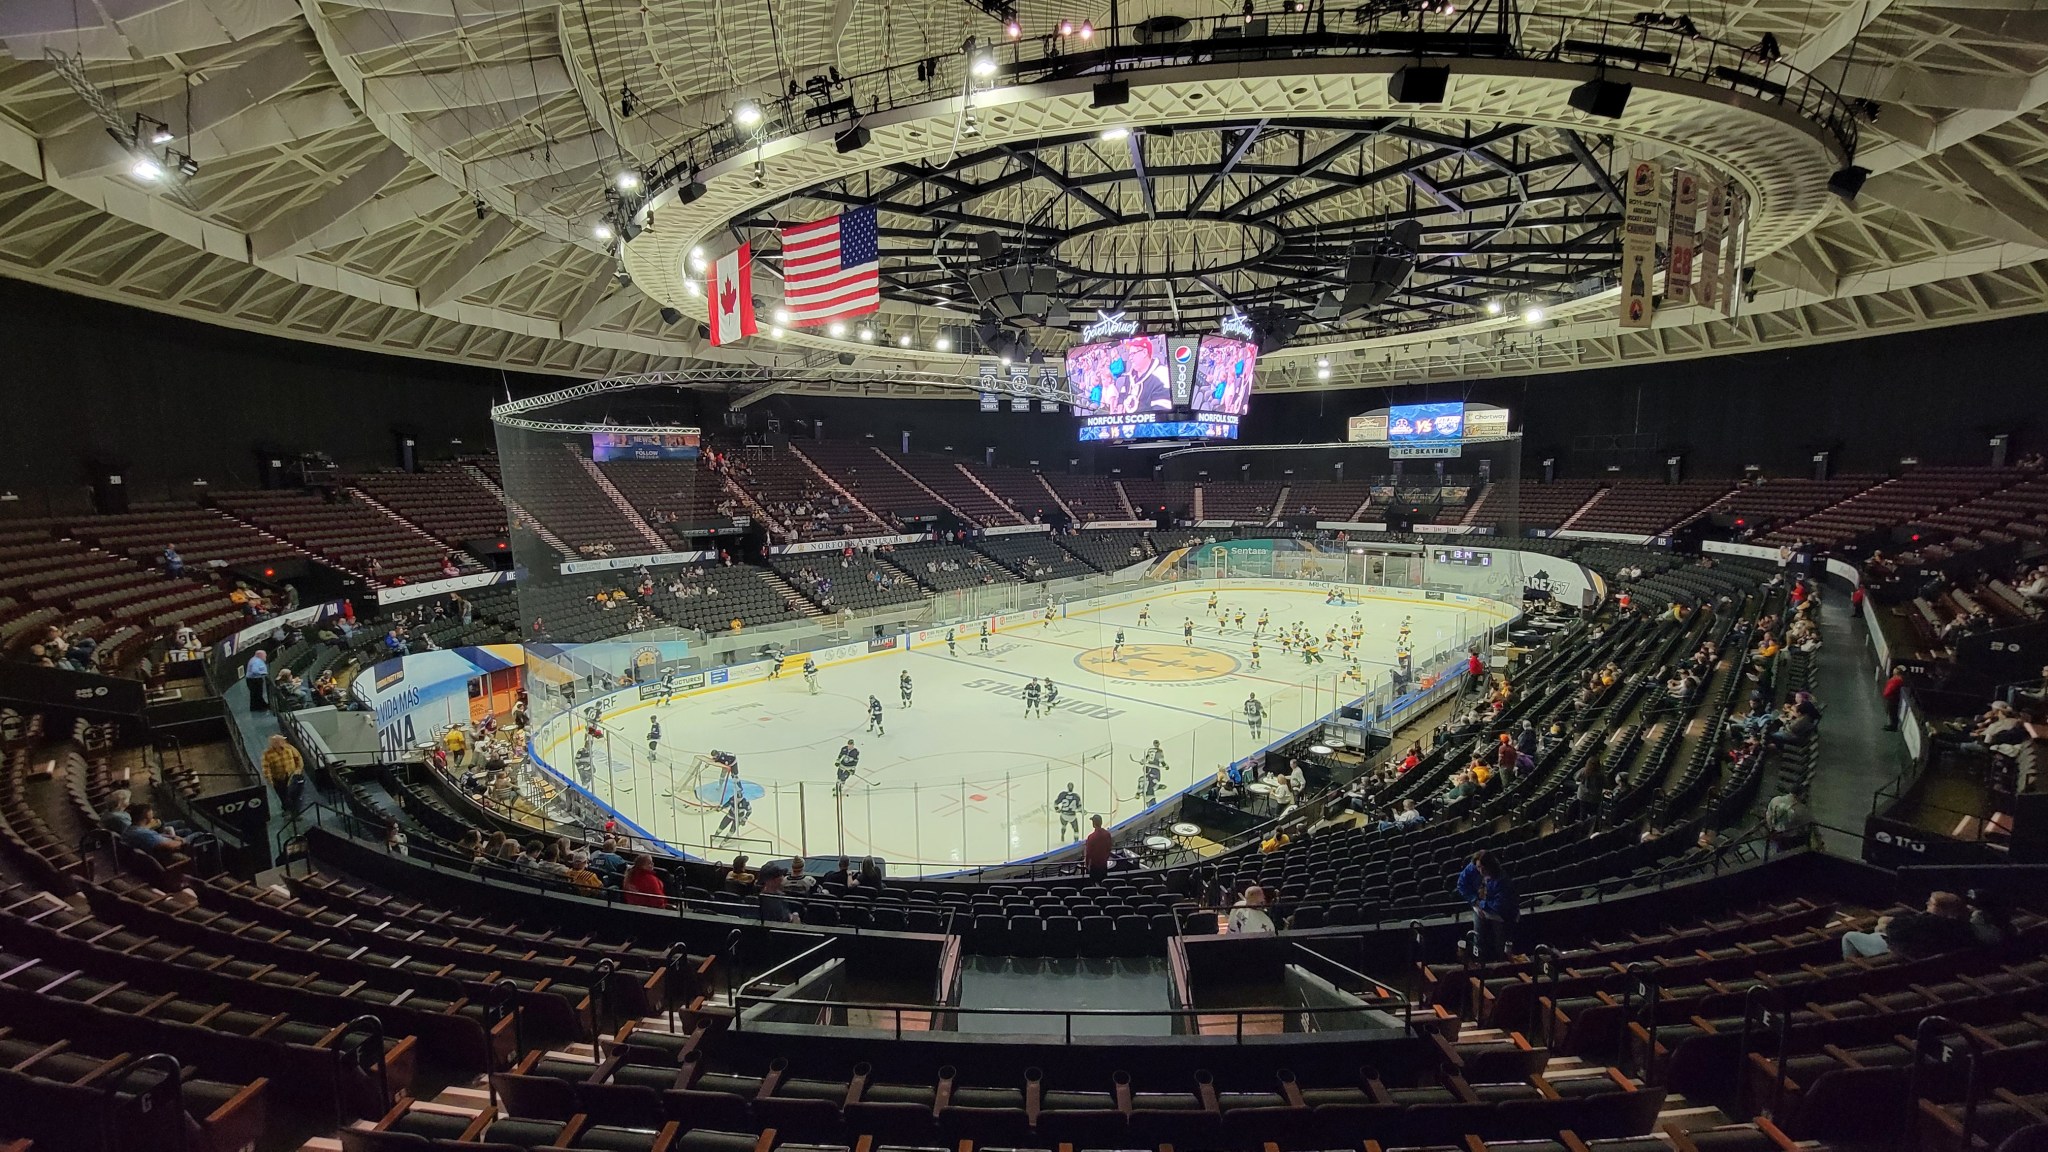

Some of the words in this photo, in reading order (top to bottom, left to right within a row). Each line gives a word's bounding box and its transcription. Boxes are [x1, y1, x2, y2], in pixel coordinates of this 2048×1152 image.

[1177, 364, 1187, 398] pepsi
[1087, 416, 1124, 427] NORFOLK
[1125, 413, 1156, 424] SCOPE
[1198, 413, 1226, 424] NORFOLK
[1226, 415, 1239, 425] SCOPE
[1475, 413, 1506, 421] Chartway
[1415, 418, 1433, 435] VS
[651, 435, 661, 446] 3
[1415, 447, 1449, 455] SKATING
[811, 540, 858, 551] NORFOLK
[1657, 537, 1667, 546] 115
[705, 551, 716, 560] 102
[771, 546, 779, 554] 101
[1231, 547, 1267, 555] Sentara
[1454, 550, 1472, 559] 13:14
[1440, 554, 1446, 563] 0
[1482, 557, 1488, 566] 0
[326, 603, 338, 617] 104
[642, 684, 661, 695] SOLID
[380, 698, 399, 722] VIDA
[399, 684, 420, 713] MÁS
[1247, 703, 1256, 714] 13
[378, 714, 416, 763] FINA
[216, 800, 246, 815] 107
[1061, 798, 1077, 811] 24
[1472, 945, 1479, 957] B
[1543, 962, 1549, 974] C
[1638, 982, 1646, 996] D
[1762, 1009, 1772, 1027] E
[1941, 1045, 1954, 1063] F
[140, 1092, 152, 1113] G
